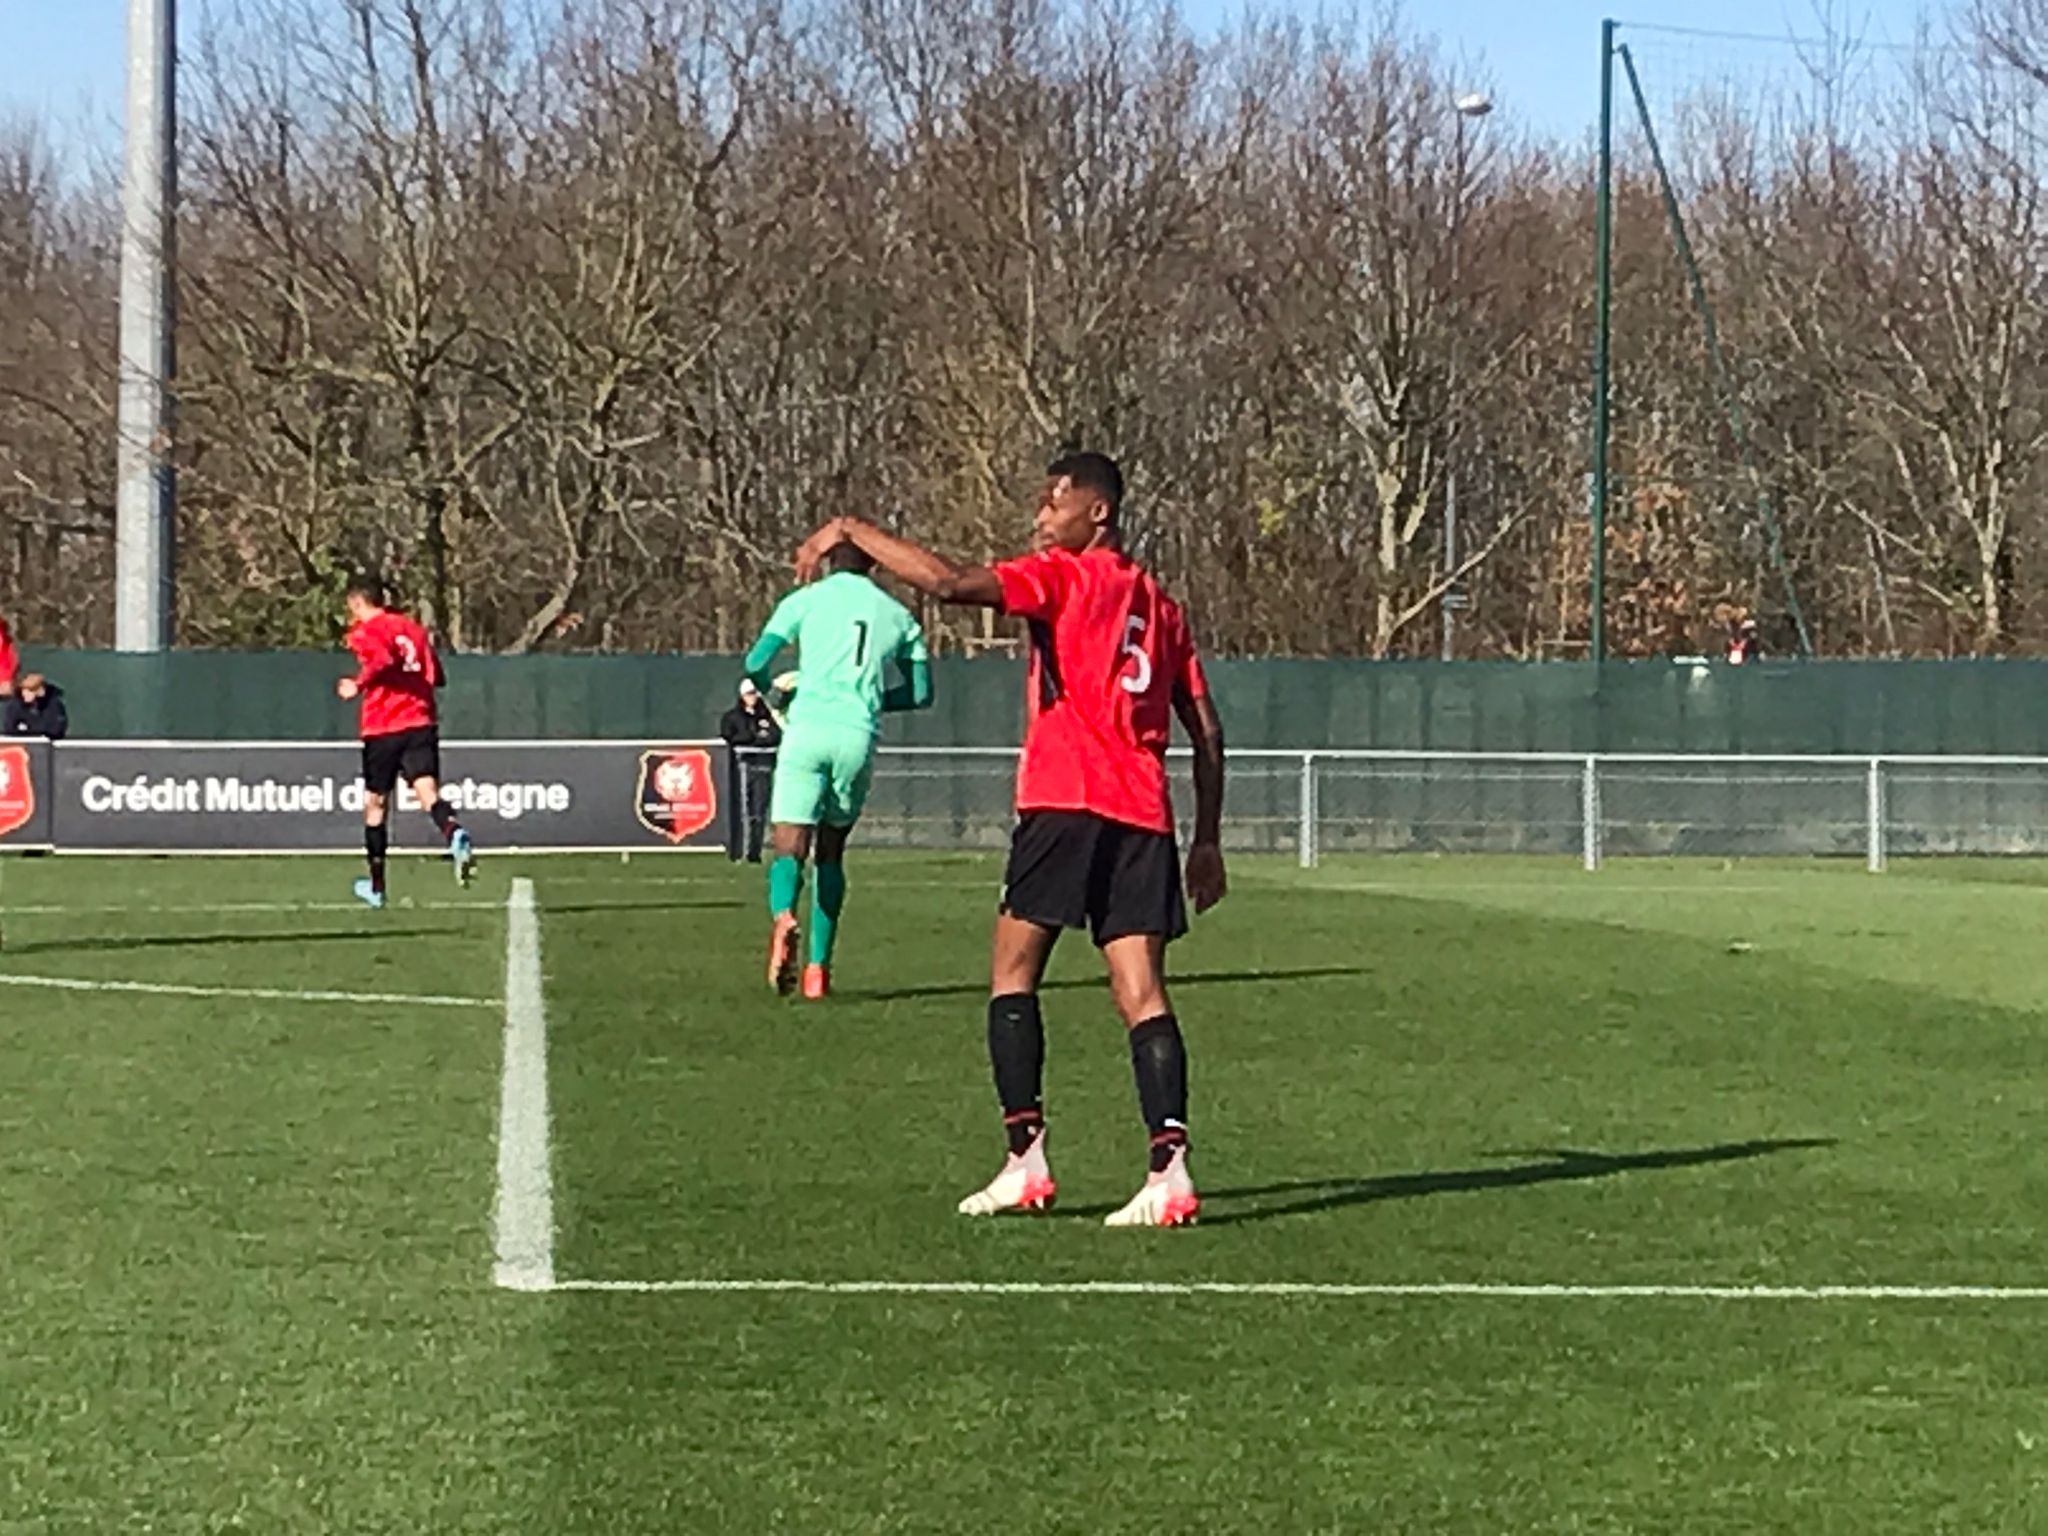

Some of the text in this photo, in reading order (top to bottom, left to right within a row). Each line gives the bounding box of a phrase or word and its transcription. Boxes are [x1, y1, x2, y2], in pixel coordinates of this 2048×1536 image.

[853, 620, 867, 667] 1
[1121, 615, 1150, 693] 5
[82, 775, 200, 812] Crédit
[204, 777, 334, 812] Mutuel
[397, 777, 570, 820] Betagne
